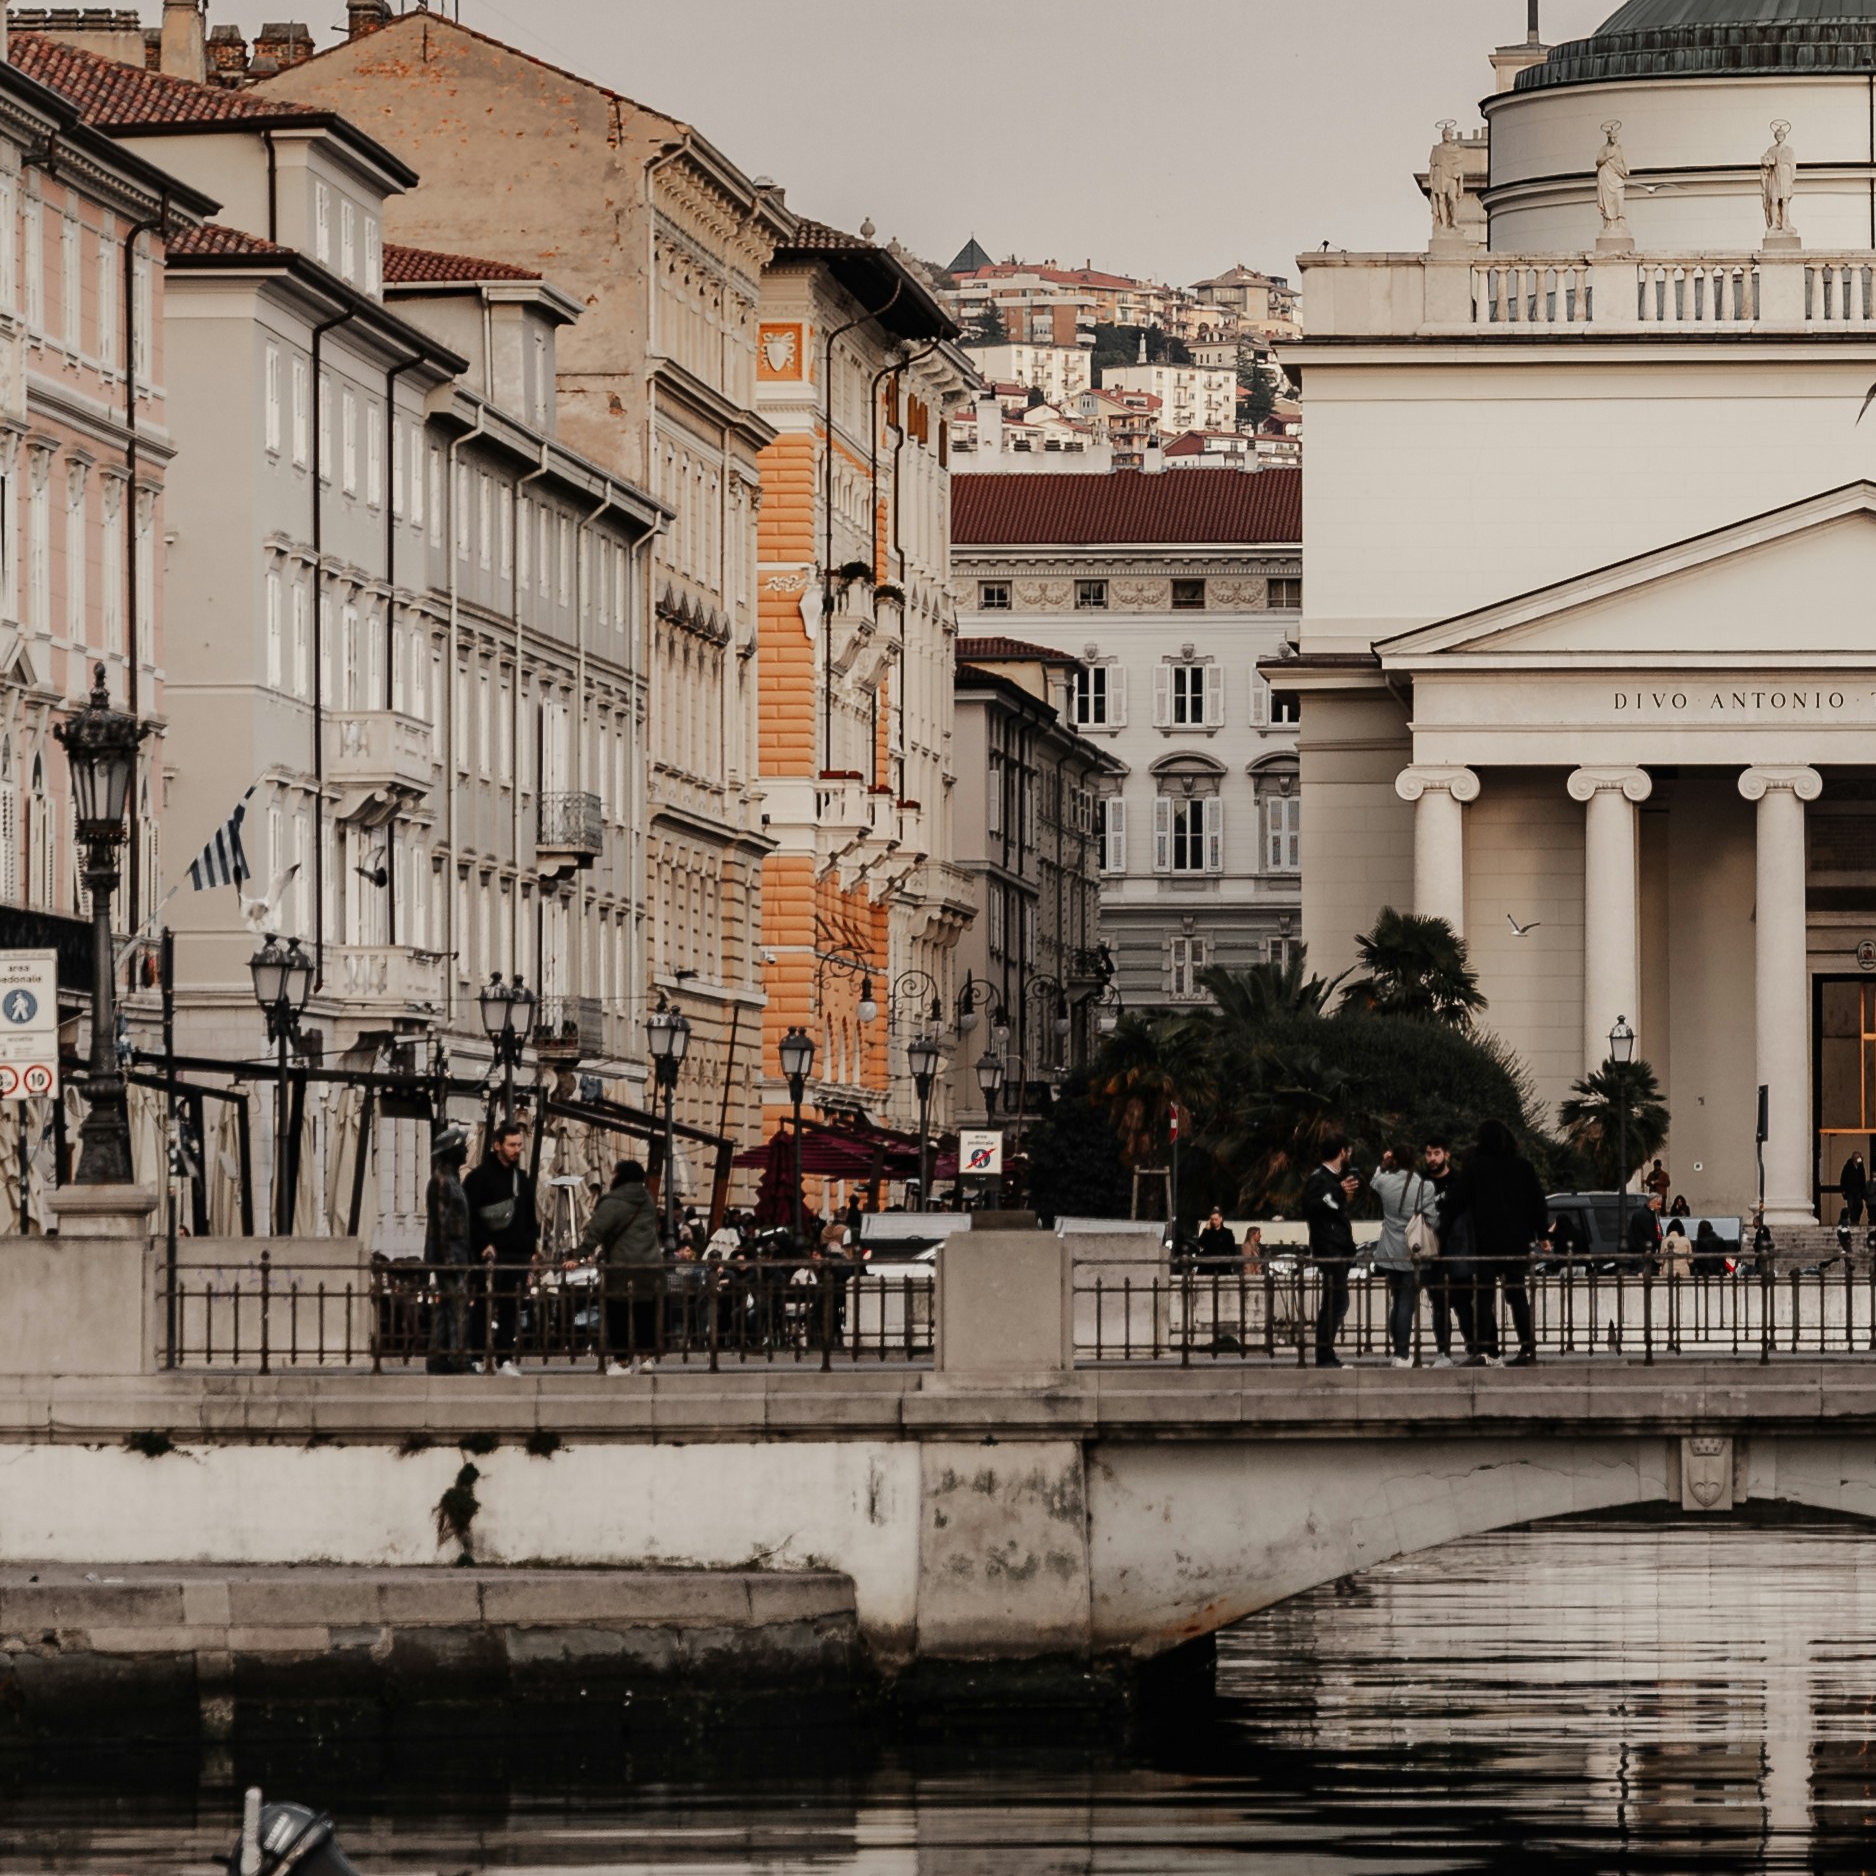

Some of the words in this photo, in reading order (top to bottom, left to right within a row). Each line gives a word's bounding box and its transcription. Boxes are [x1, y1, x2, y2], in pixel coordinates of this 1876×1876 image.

[1614, 692, 1688, 709] DIVO
[1710, 692, 1845, 709] ANTONIO
[31, 1073, 44, 1086] 10
